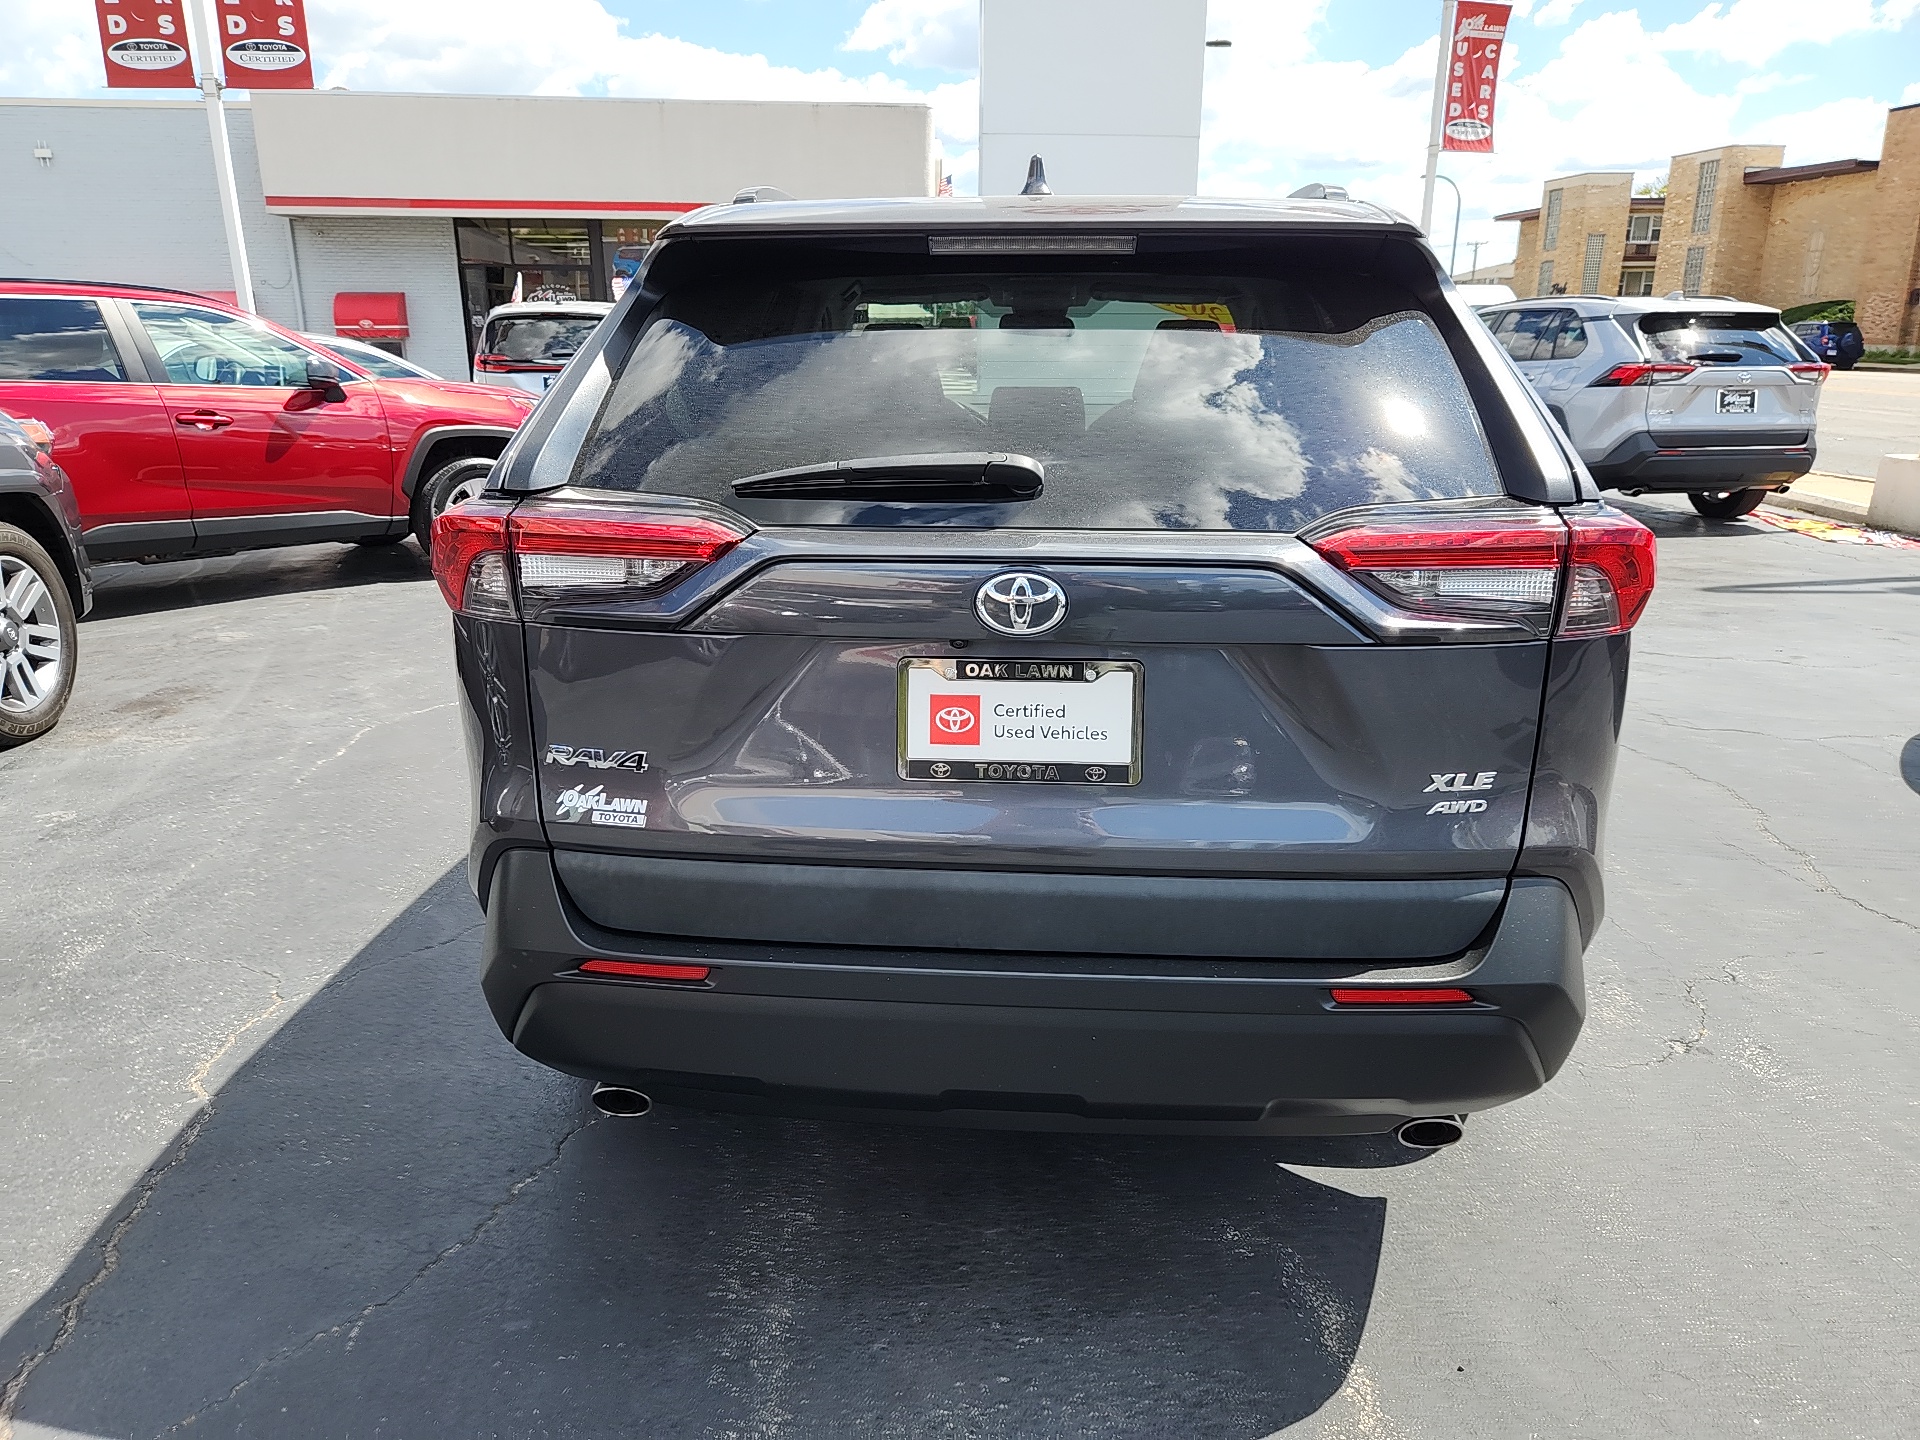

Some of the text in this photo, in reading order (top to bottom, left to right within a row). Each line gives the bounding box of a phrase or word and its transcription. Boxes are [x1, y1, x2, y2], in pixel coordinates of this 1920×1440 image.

[1449, 42, 1468, 116] USED
[1478, 44, 1497, 119] CARS
[965, 663, 1074, 678] OAK LAWN
[993, 703, 1066, 718] Certified
[994, 725, 1108, 741] Used Vehicles
[545, 744, 649, 773] RAV4
[974, 763, 1060, 780] TOYOTA
[1422, 771, 1498, 793] XLE
[1425, 799, 1488, 815] AWD
[599, 813, 638, 824] TOYOTA
